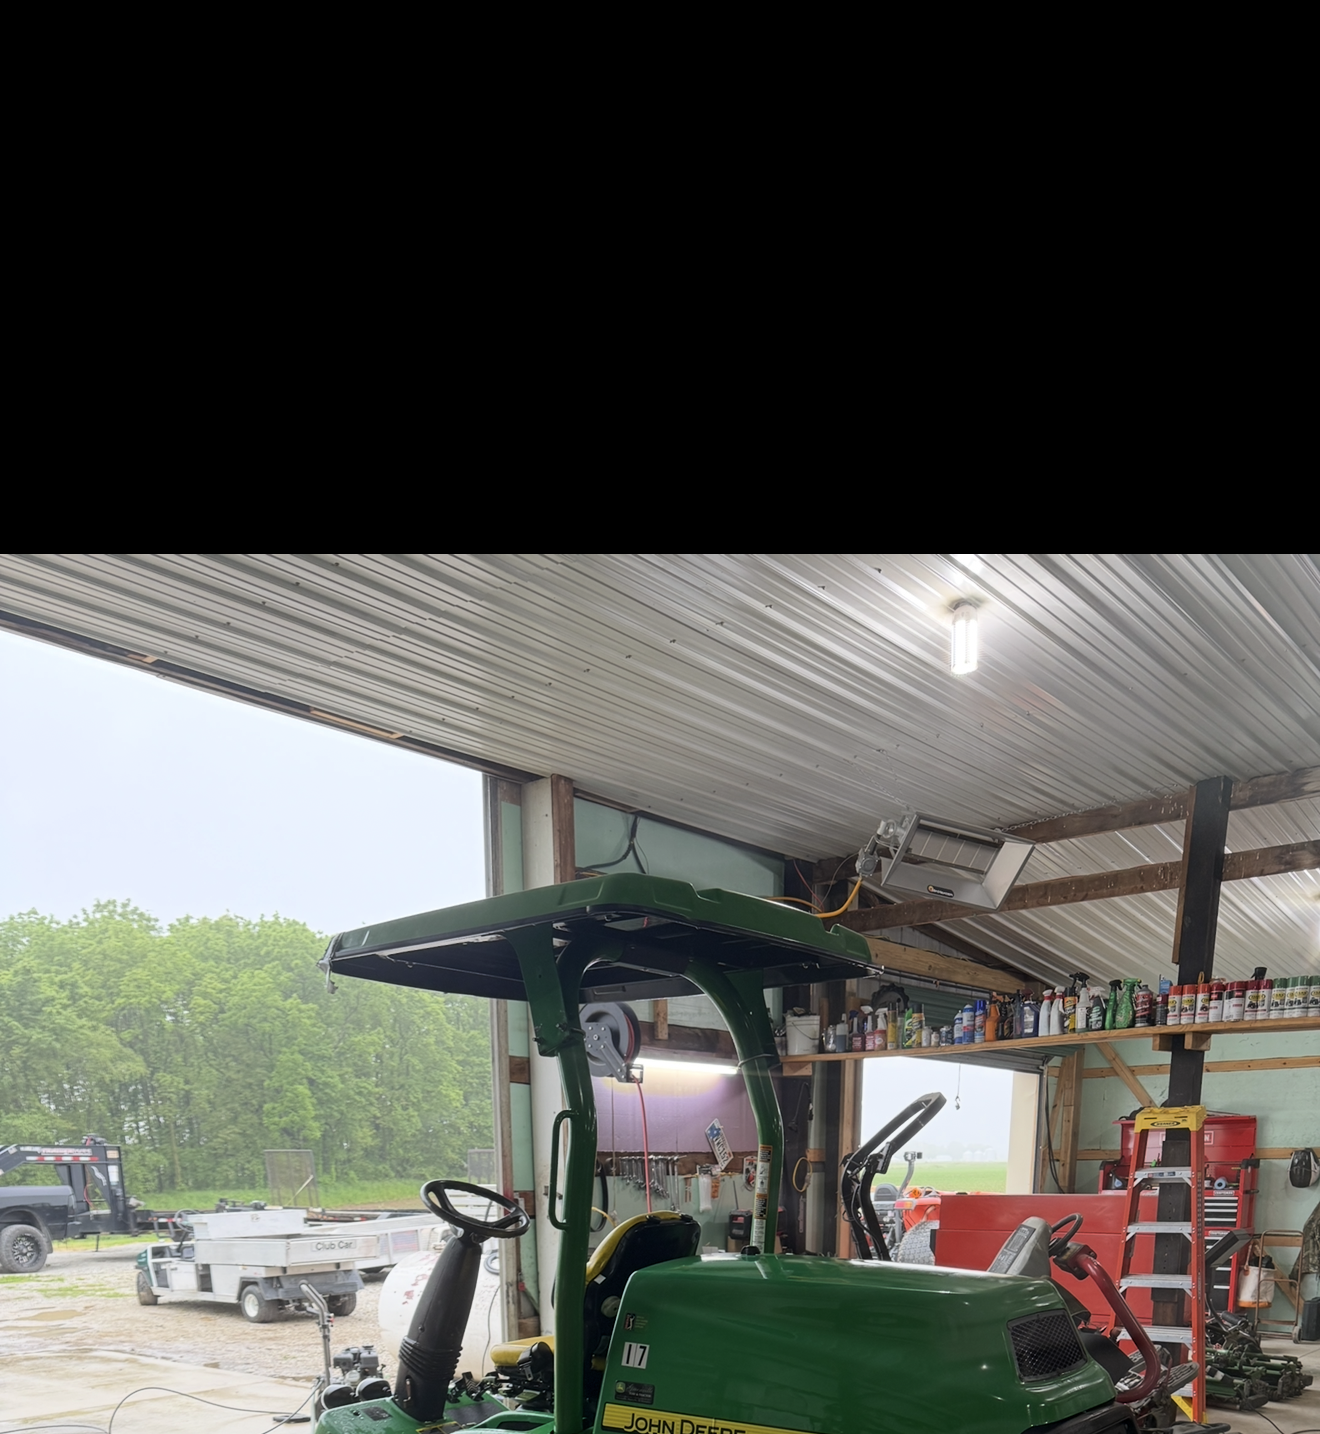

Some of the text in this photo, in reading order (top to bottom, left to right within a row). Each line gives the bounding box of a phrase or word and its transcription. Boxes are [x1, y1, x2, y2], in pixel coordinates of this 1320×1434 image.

[316, 1240, 353, 1251] Club Car
[625, 1343, 648, 1367] 17
